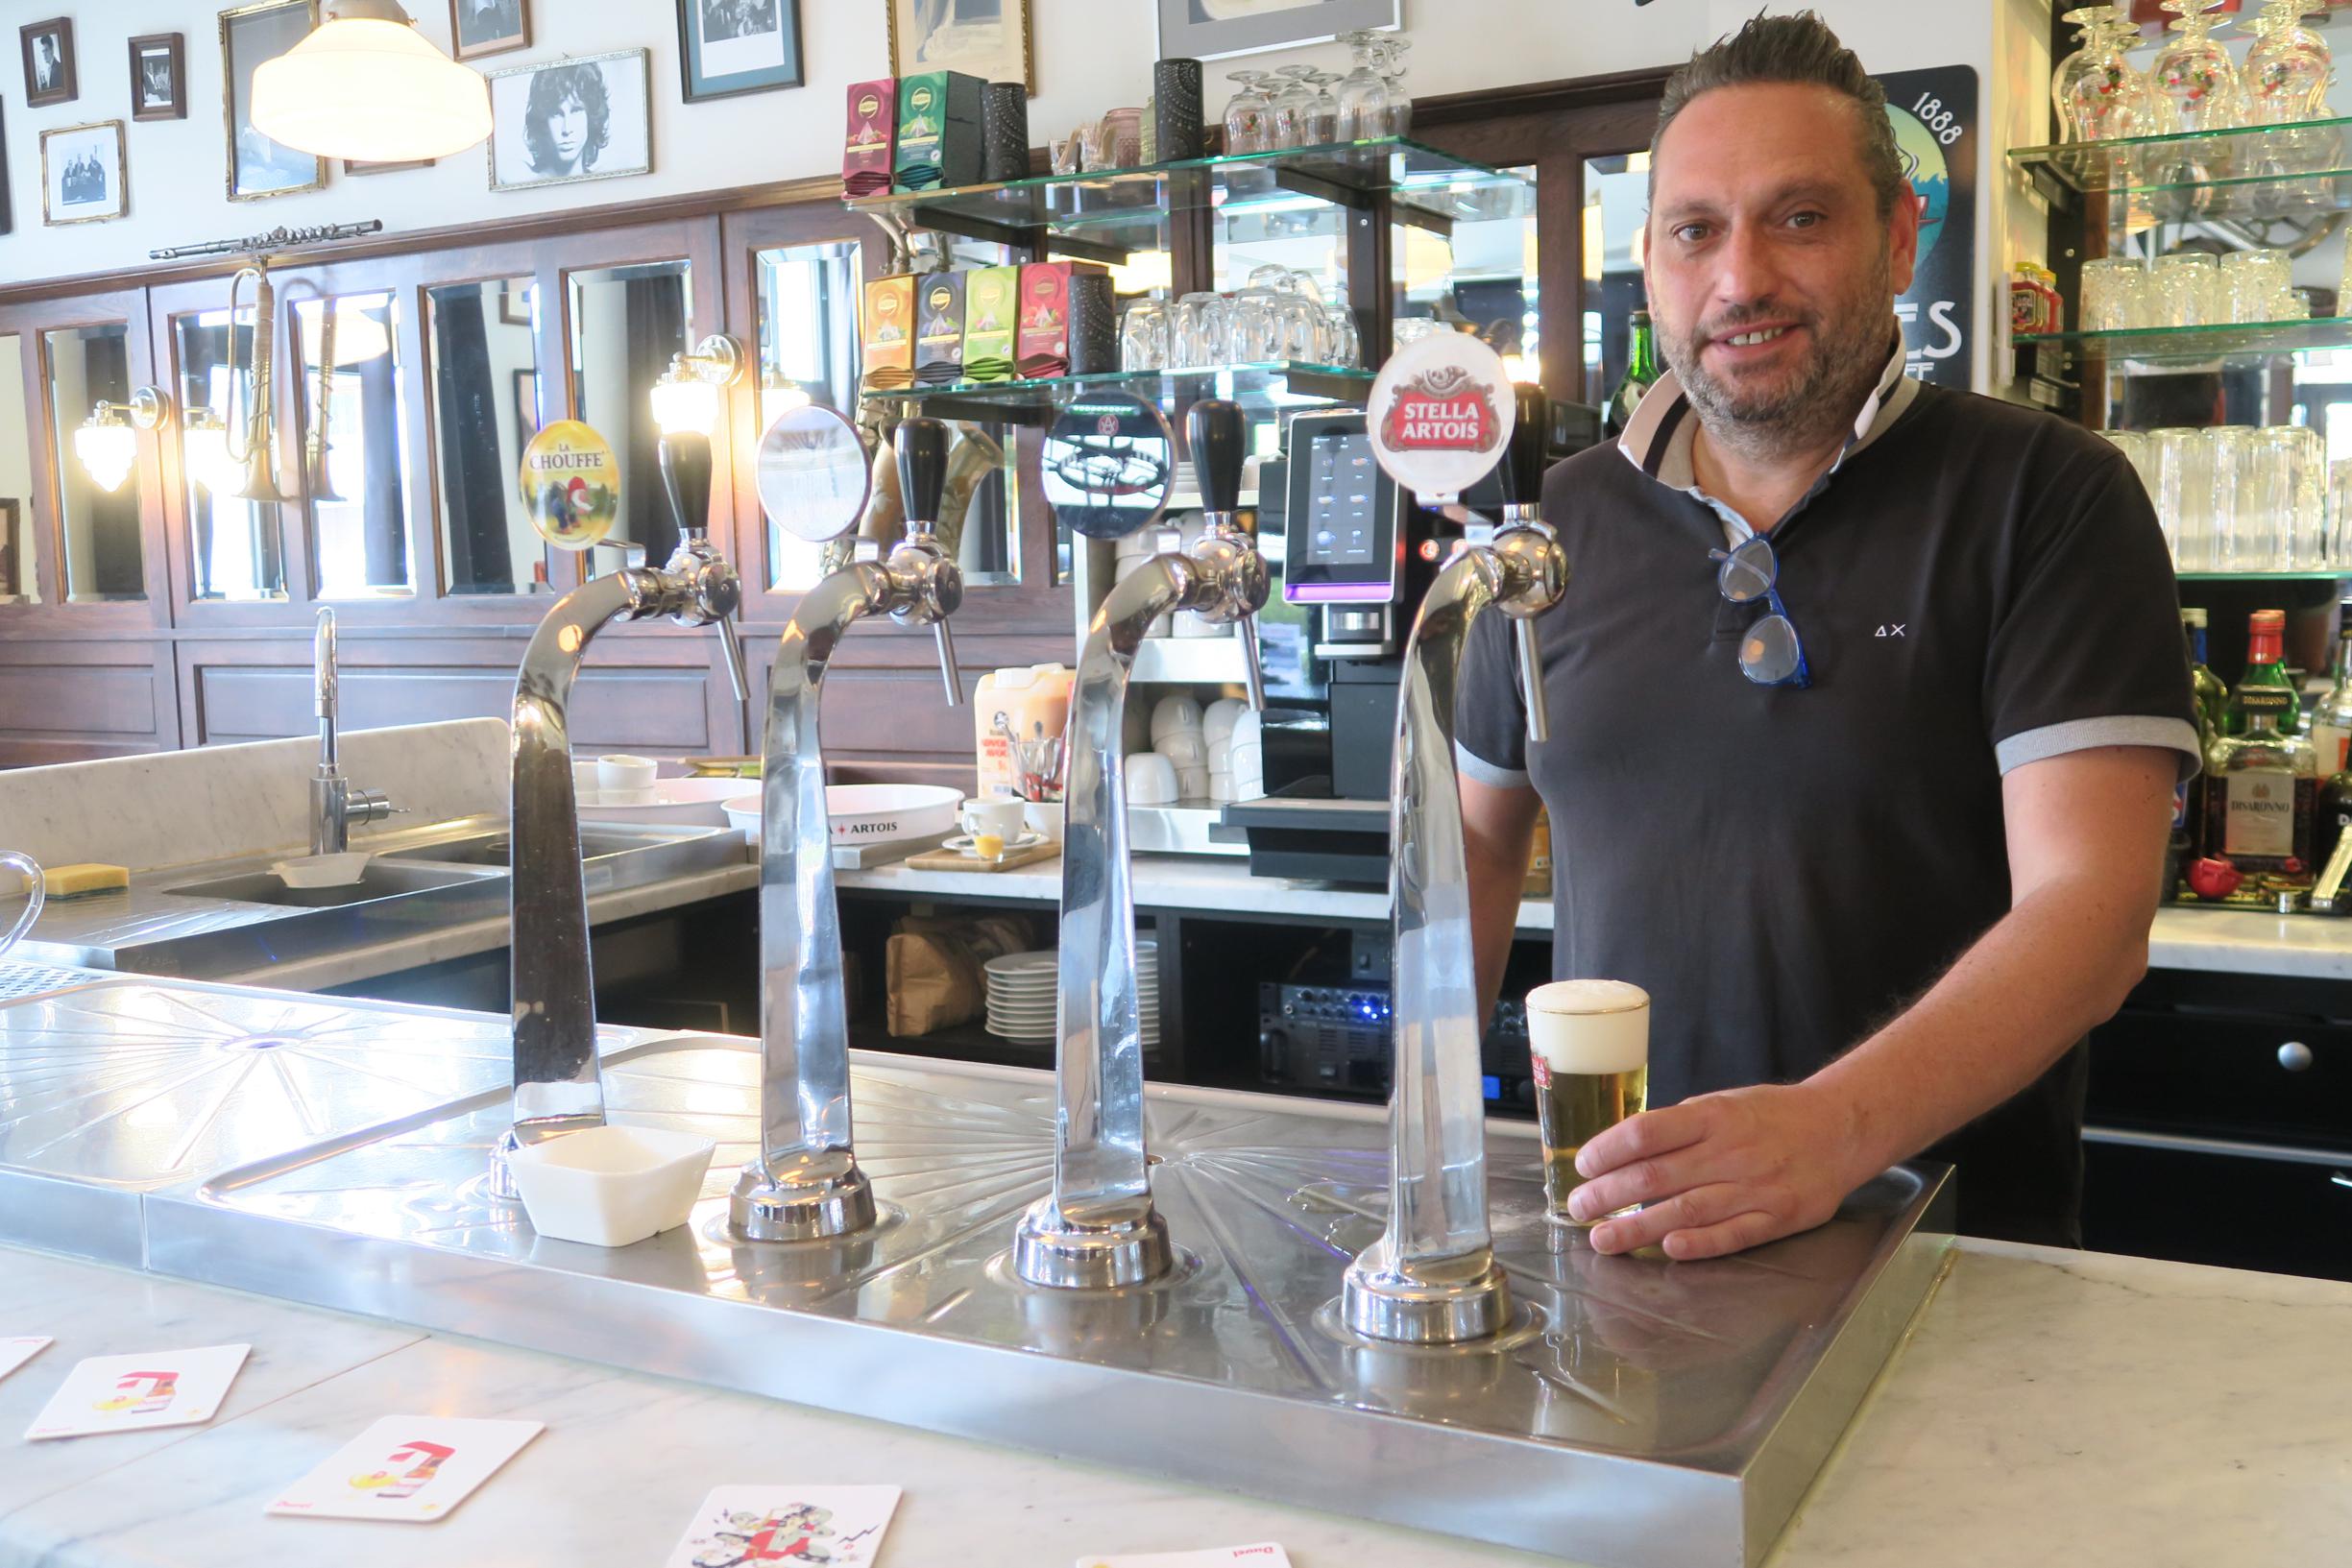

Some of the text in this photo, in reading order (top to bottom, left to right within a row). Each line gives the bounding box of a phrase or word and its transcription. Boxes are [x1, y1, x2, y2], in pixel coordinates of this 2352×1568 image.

[1911, 91, 1963, 145] 1888
[1403, 401, 1479, 421] STELLA
[1401, 422, 1479, 440] ARTOIS
[558, 443, 570, 452] LA
[529, 452, 603, 470] CHOUFFE
[2230, 800, 2290, 813] DISARONNO
[850, 821, 898, 834] ARTOIS
